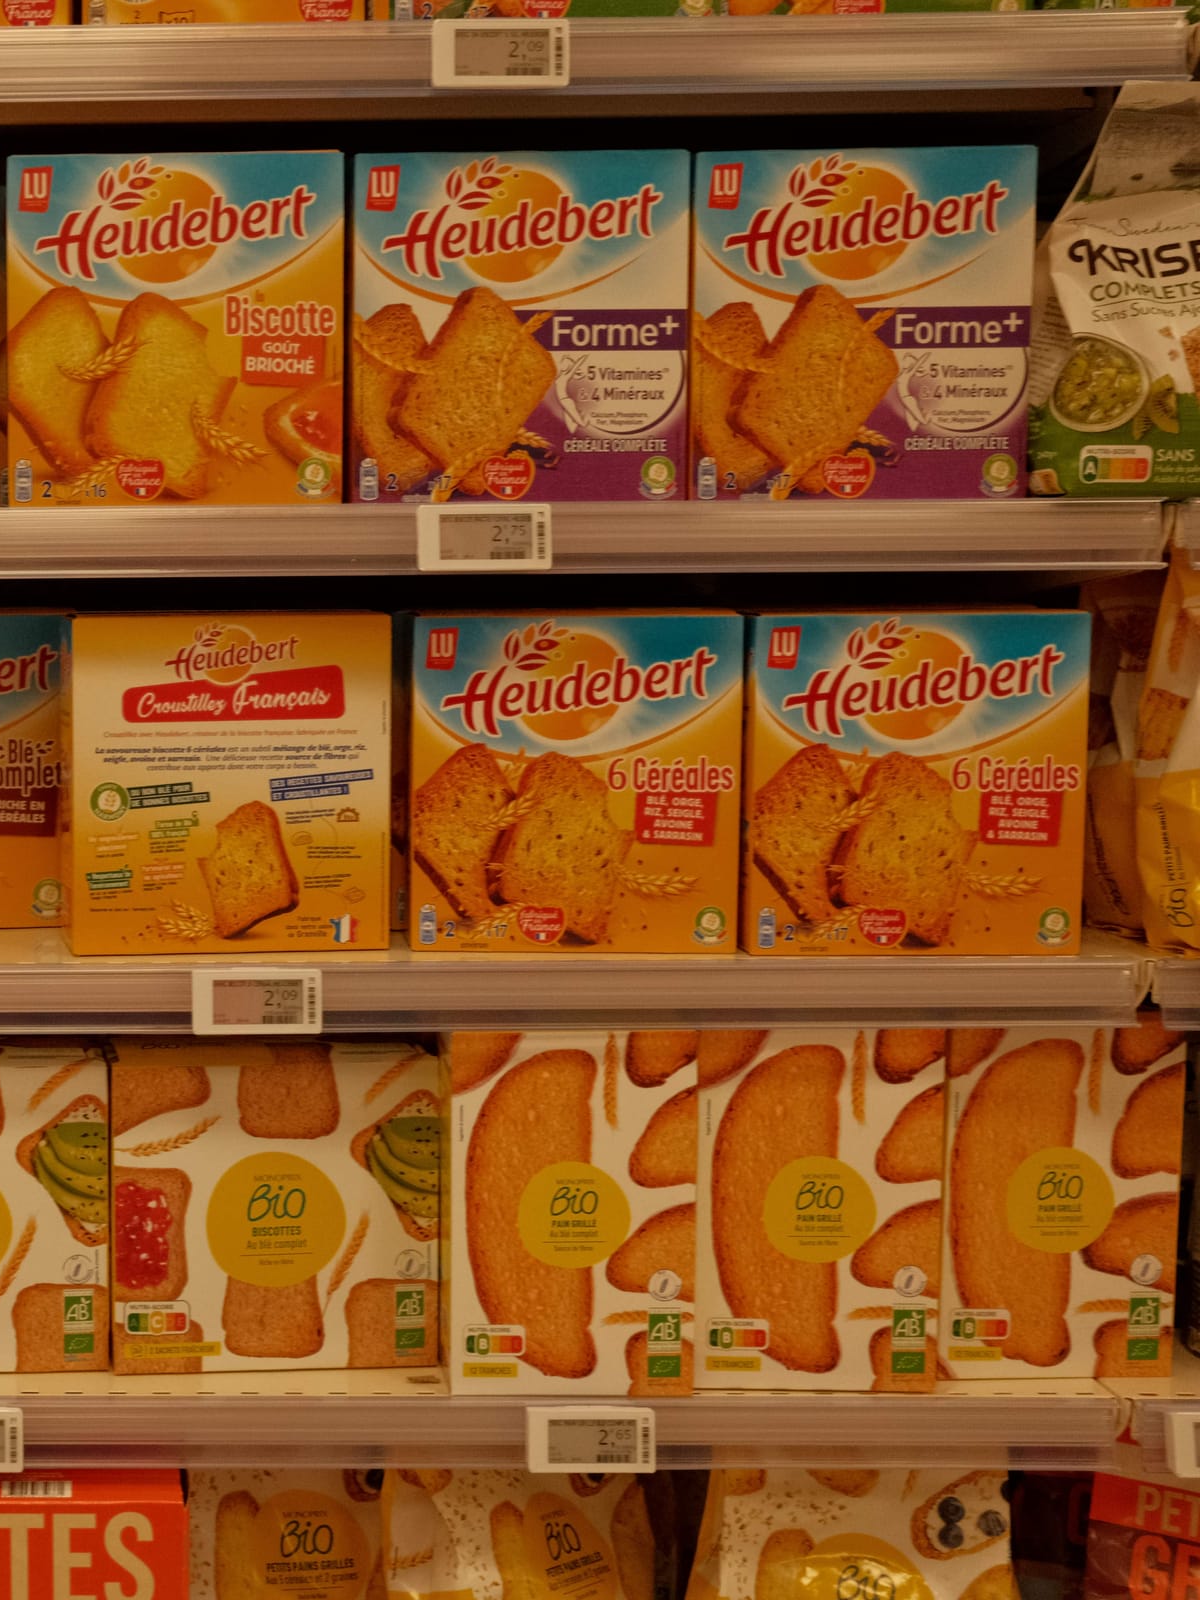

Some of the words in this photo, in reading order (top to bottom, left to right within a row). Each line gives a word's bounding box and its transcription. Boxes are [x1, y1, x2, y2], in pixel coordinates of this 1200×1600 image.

[423, 2, 433, 20] 2
[23, 171, 48, 200] LU
[372, 170, 396, 198] LU
[713, 169, 739, 197] LU
[35, 187, 315, 280] Heudebert
[383, 185, 663, 278] Heudebert
[725, 183, 1008, 276] Heudebert
[226, 295, 335, 336] Biscotte
[552, 315, 679, 346] Forme+
[895, 313, 1024, 344] Forme+
[262, 340, 300, 356] GOÛT
[245, 356, 315, 375] BRIOCHÉ
[587, 367, 596, 381] 5
[929, 363, 938, 379] 5
[604, 386, 664, 400] Minéraux
[945, 382, 1008, 399] Minéraux
[563, 437, 611, 453] CÉRÉALE
[611, 436, 667, 452] COMPLÈTE
[904, 436, 952, 451] CÉRÉALE
[952, 434, 1009, 450] COMPLÈTE
[1156, 449, 1195, 461] SANS
[1085, 462, 1096, 474] A
[386, 473, 398, 490] 2
[431, 633, 455, 658] LU
[771, 631, 797, 658] LU
[165, 636, 300, 680] Heudebert
[232, 682, 331, 715] Français
[442, 648, 717, 736] Heudebert
[784, 645, 1065, 737] Heudebert
[8, 739, 33, 764] Blé
[608, 758, 627, 791] 6
[633, 758, 734, 791] Céréales
[953, 757, 971, 791] 6
[979, 756, 1080, 791] Céréales
[29, 800, 45, 812] EN
[653, 831, 703, 841] SARRASIN
[654, 819, 694, 829] AVOINE
[998, 820, 1038, 830] AVOINE
[998, 831, 1048, 842] SARRASIN
[795, 1180, 844, 1211] Bio
[1036, 1171, 1084, 1202] Bio
[246, 1183, 306, 1222] Bio
[550, 1186, 599, 1217] Bio
[252, 1226, 302, 1237] BISCOTTES
[274, 1238, 307, 1252] complet
[151, 1317, 164, 1329] C
[895, 1318, 921, 1337] AB
[964, 1322, 974, 1334] B
[280, 1520, 334, 1558] Bio
[544, 1522, 582, 1560] Bio
